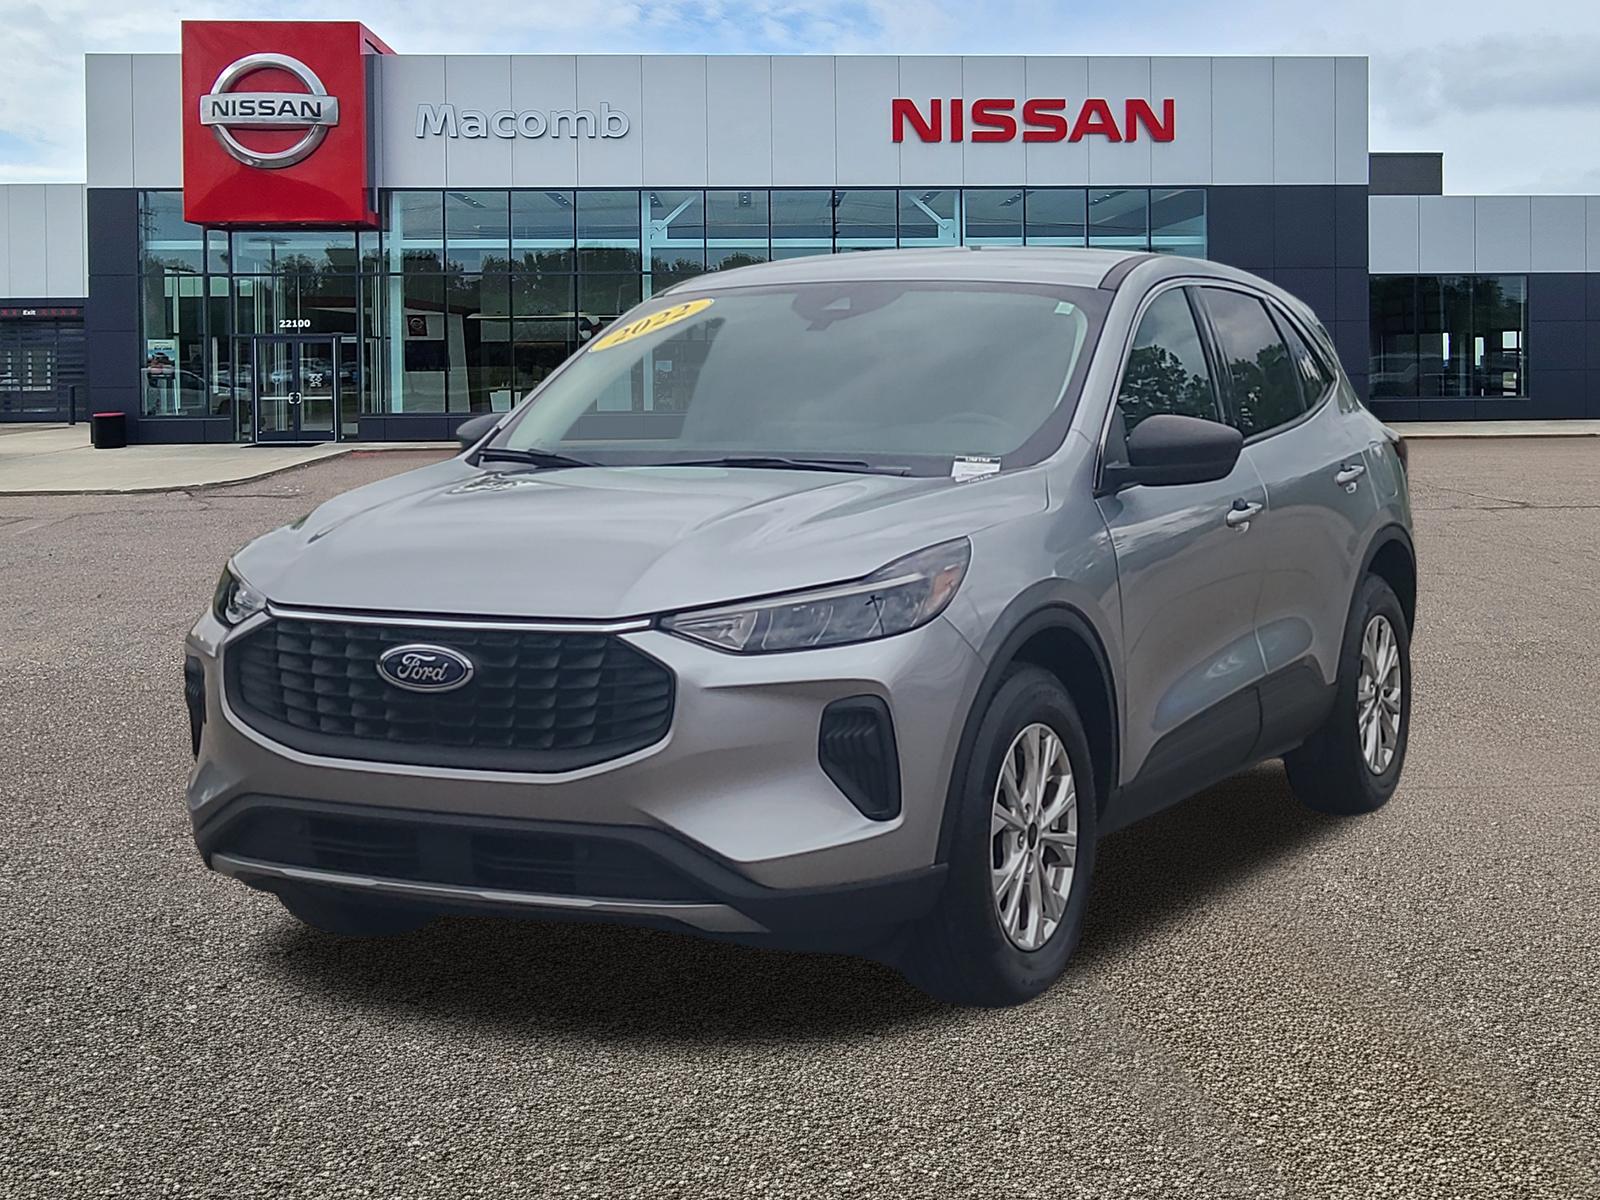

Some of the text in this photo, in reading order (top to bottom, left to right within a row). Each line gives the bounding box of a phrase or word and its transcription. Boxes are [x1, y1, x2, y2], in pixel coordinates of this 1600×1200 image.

[212, 100, 321, 117] NISSAN
[415, 102, 630, 138] Macomb
[892, 98, 1175, 142] NISSAN
[279, 319, 311, 328] 22100
[612, 304, 691, 344] 2022
[397, 653, 448, 680] Ford
